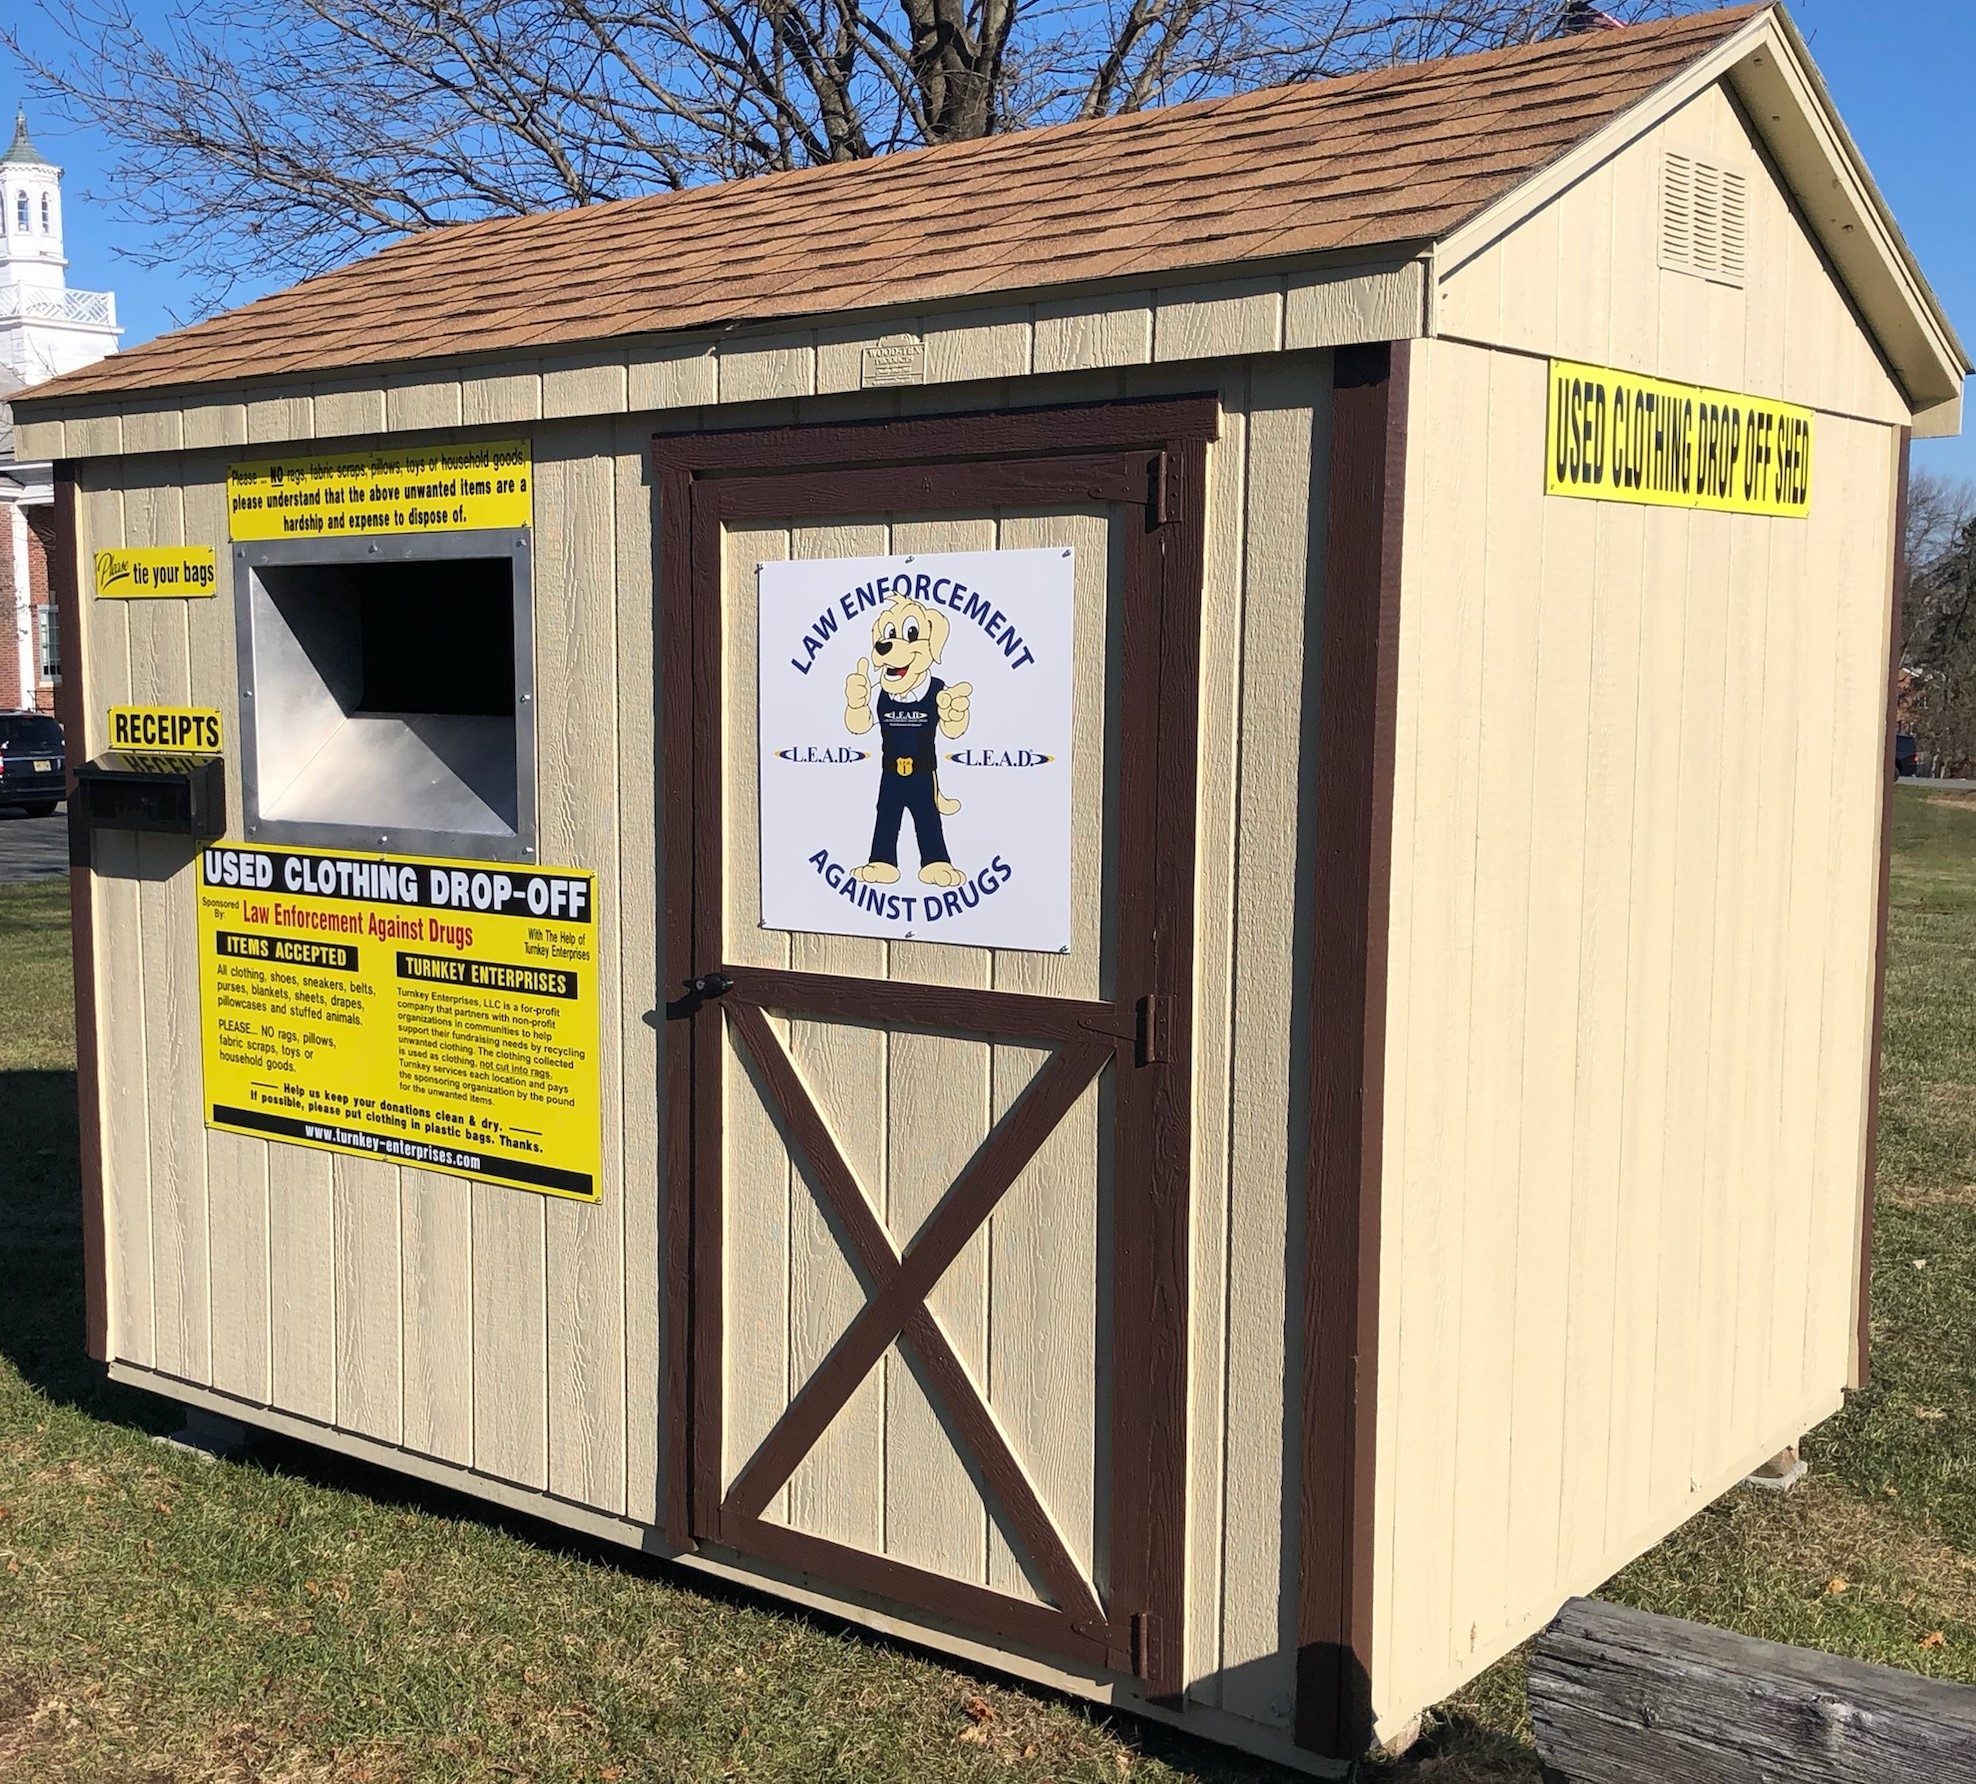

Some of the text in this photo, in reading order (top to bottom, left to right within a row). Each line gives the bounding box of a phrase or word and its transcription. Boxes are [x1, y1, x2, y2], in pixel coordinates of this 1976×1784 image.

[1556, 377, 1809, 504] USED CLOTHING DROP OFF SHED
[231, 468, 256, 486] Please
[270, 466, 283, 483] NO
[310, 461, 332, 480] fabric
[406, 456, 424, 477] toys
[428, 457, 438, 472] or
[441, 449, 488, 471] household
[232, 477, 526, 514] please understand that the above unwanted items are a
[283, 504, 466, 533] hardship and expense to dispose of.
[133, 562, 149, 584] tie
[152, 565, 179, 589] your
[183, 560, 214, 588] bags
[791, 573, 1035, 675] LAW ENFORCEMENT
[115, 713, 219, 747] RECEIPTS
[205, 850, 587, 917] USED CLOTHING DROP-OFF
[808, 848, 1013, 922] AGAINST DRUGS
[201, 896, 239, 909] Sponsored
[214, 908, 225, 920] By:
[243, 899, 473, 951] Law Enforcement Against Drugs
[527, 927, 585, 946] With The Help of
[227, 935, 346, 966] ITEMS ACCEPTED
[523, 941, 590, 961] Turnkey Enterprises
[216, 963, 227, 975] All
[405, 956, 566, 994] TURNKEY ENTERPRISES
[217, 994, 267, 1012] pillowcases
[270, 1003, 286, 1014] and
[289, 1005, 322, 1020] stuffed
[396, 986, 429, 1001] Turnkey
[483, 998, 501, 1009] LLC
[503, 1001, 511, 1010] is
[520, 1003, 560, 1017] for-profit
[397, 1000, 556, 1029] company that partners with non-profit
[261, 1024, 274, 1038] NO
[397, 1012, 552, 1042] organizations in communities to help
[397, 1024, 585, 1060] support their fundraising needs by recycling
[219, 1033, 243, 1048] fabric
[281, 1043, 301, 1059] toys
[304, 1049, 313, 1059] or
[219, 1049, 263, 1067] household
[398, 1036, 437, 1048] unwanted
[477, 1045, 494, 1057] The
[495, 1049, 531, 1065] clothing
[533, 1056, 574, 1069] collected
[398, 1046, 406, 1055] is
[407, 1049, 427, 1059] used
[429, 1052, 439, 1061] as
[479, 1060, 494, 1070] not
[495, 1063, 510, 1073] cut
[510, 1063, 528, 1075] into
[398, 1057, 569, 1094] Turnkey services each location and pays
[398, 1070, 575, 1107] the sponsoring organization by the pound
[399, 1081, 411, 1091] for
[412, 1083, 425, 1094] the
[427, 1088, 467, 1101] unwanted
[250, 1089, 257, 1100] If
[308, 1101, 341, 1116] please
[345, 1109, 361, 1119] put
[366, 1111, 407, 1130] clothing
[410, 1117, 420, 1130] in
[424, 1121, 461, 1137] plastic
[283, 1082, 305, 1097] Help
[308, 1089, 320, 1099] us
[324, 1089, 349, 1105] keep
[353, 1097, 375, 1108] your
[379, 1099, 431, 1118] donations
[435, 1109, 464, 1124] clean
[468, 1114, 476, 1127] &
[305, 1125, 480, 1169] www.turnkey-enterprises.com
